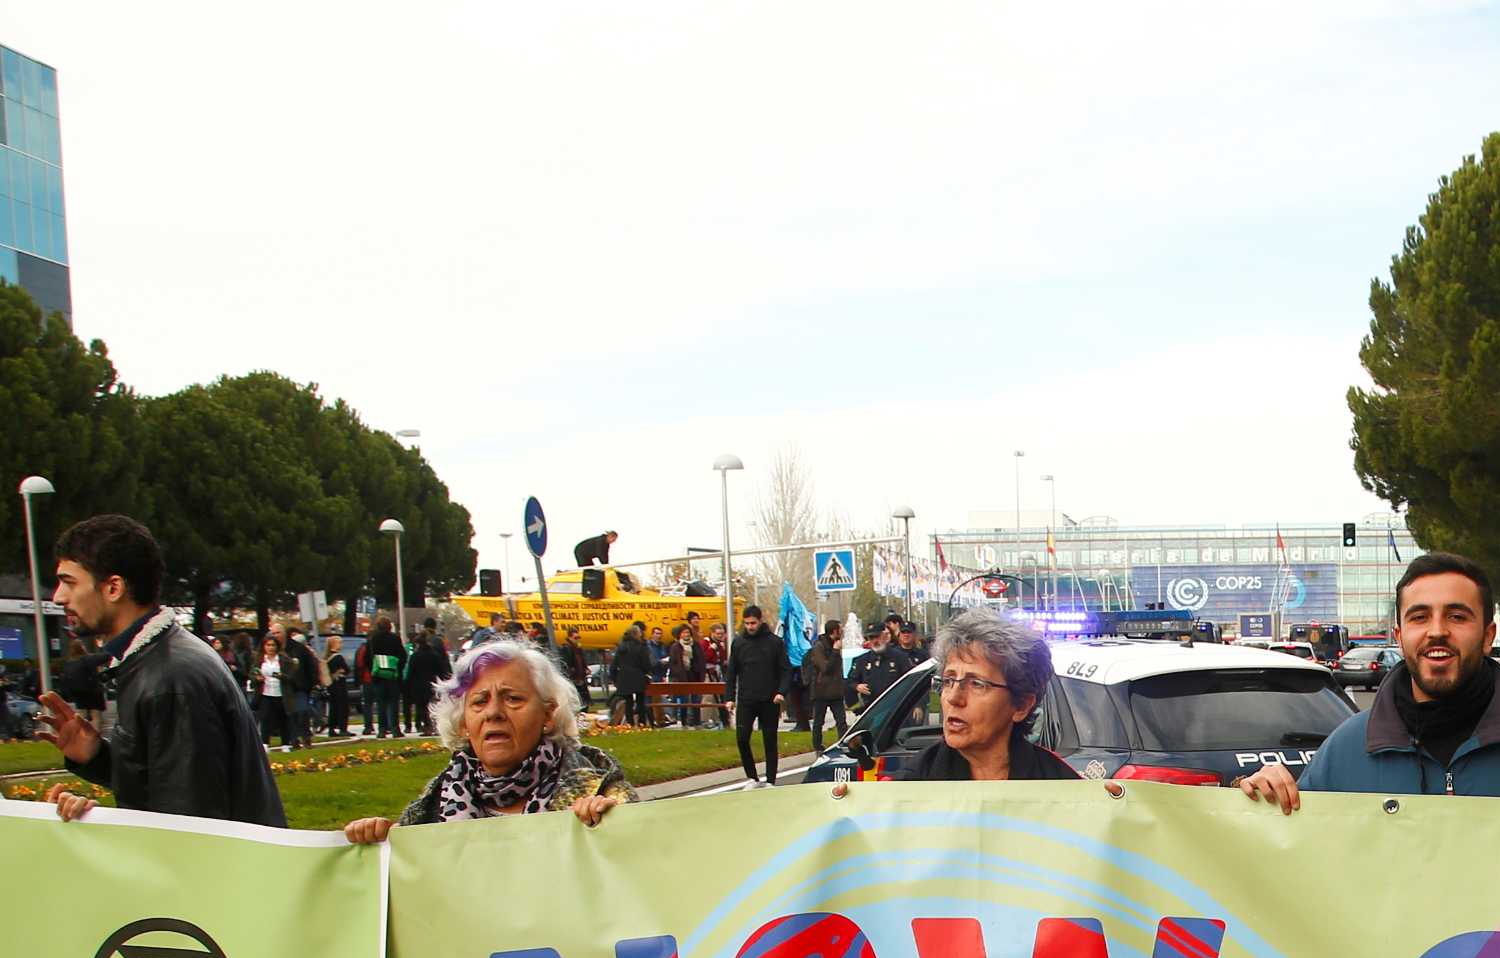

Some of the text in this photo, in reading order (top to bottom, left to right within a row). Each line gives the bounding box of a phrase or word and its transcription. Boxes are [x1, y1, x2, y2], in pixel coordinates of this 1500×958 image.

[1201, 547, 1233, 563] de
[1216, 576, 1262, 591] COP25
[551, 612, 633, 620] CLIMATE JUSTICE NOW
